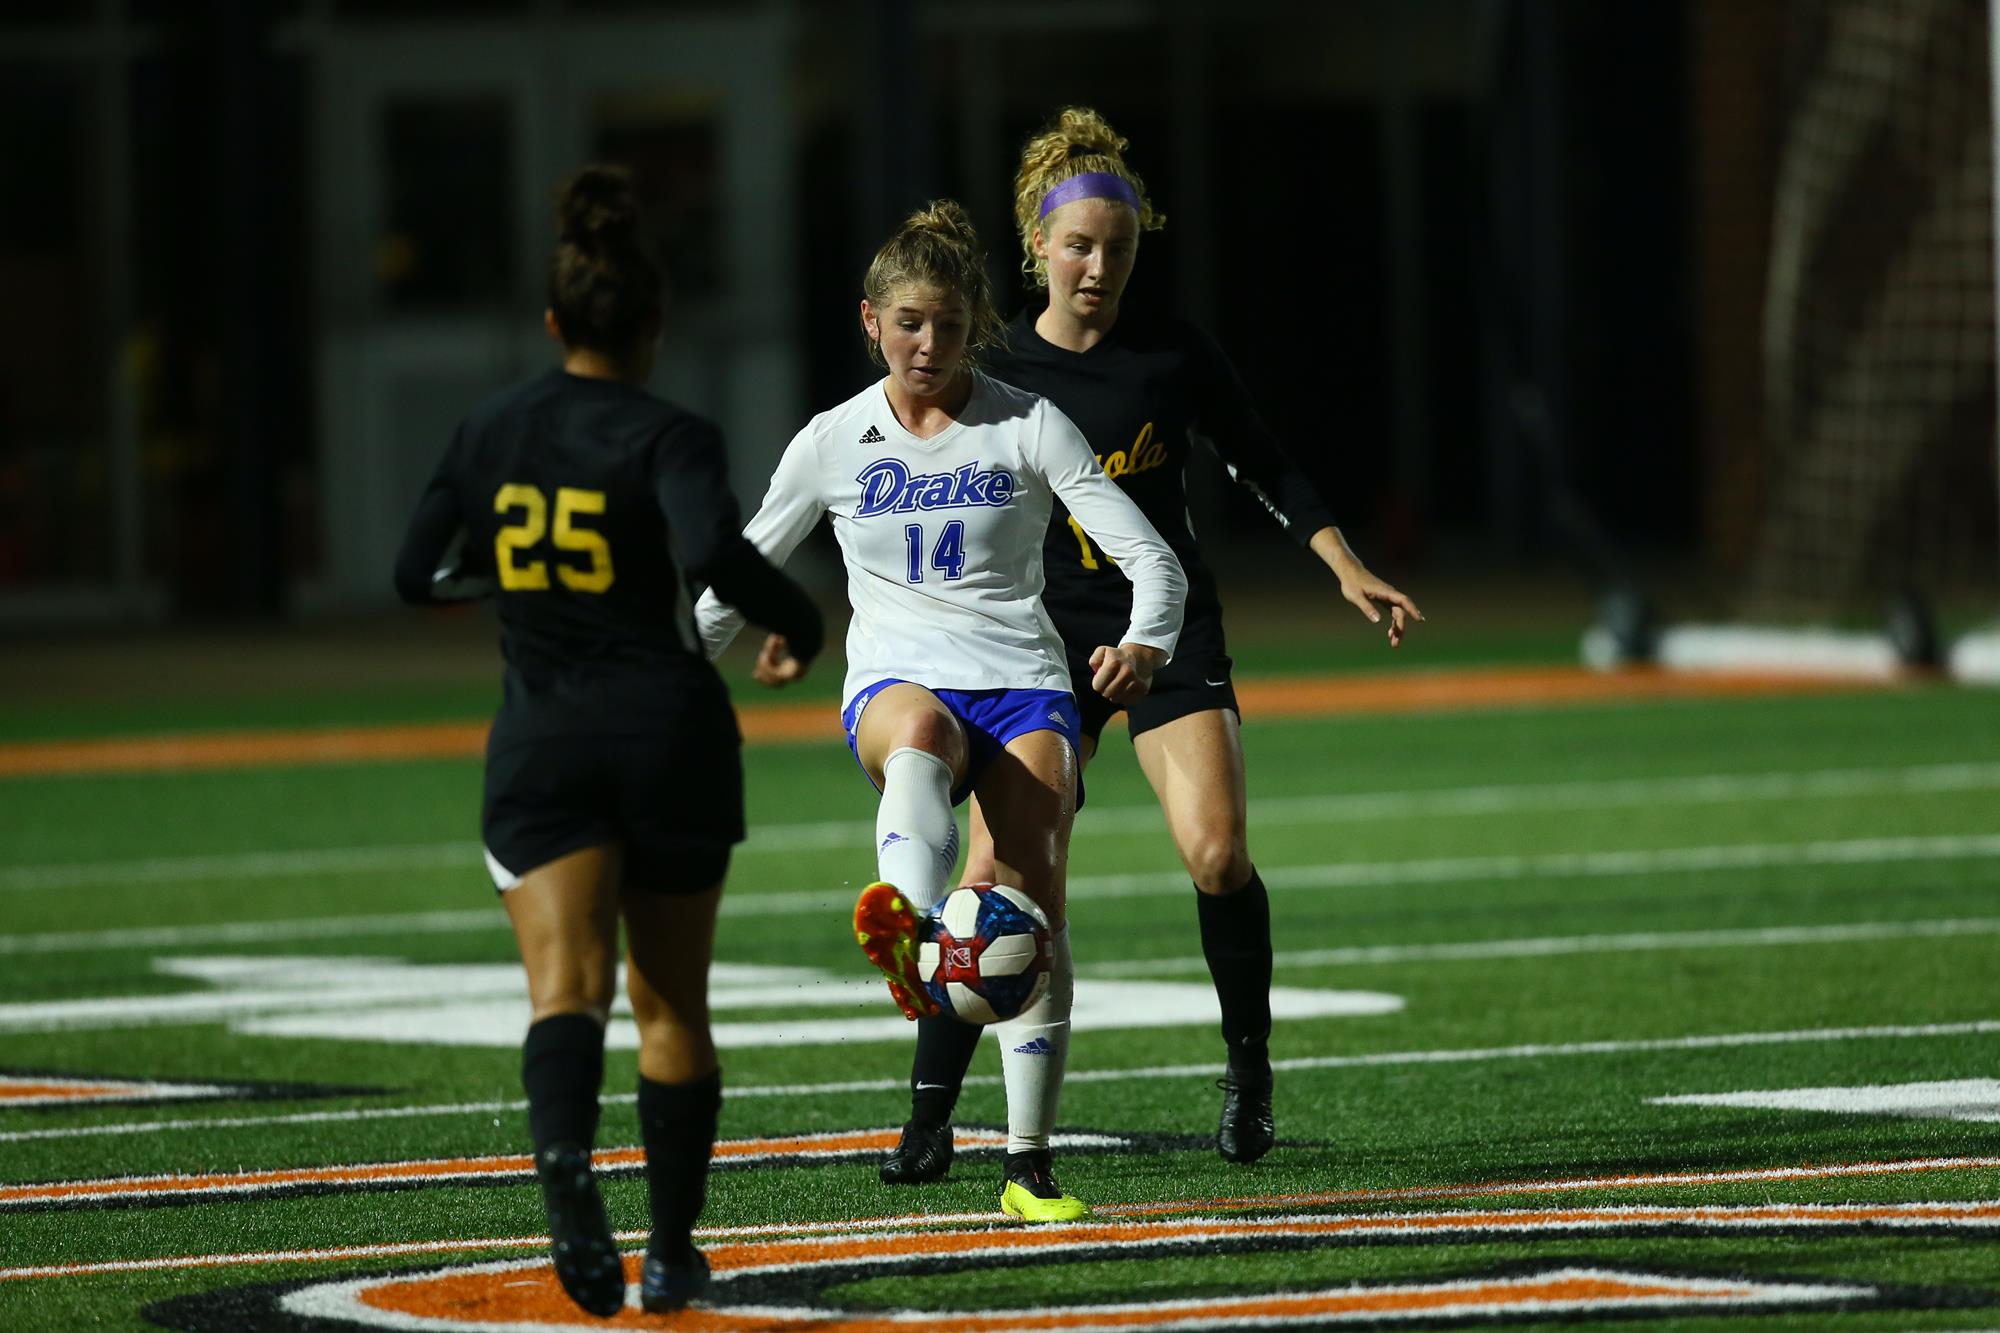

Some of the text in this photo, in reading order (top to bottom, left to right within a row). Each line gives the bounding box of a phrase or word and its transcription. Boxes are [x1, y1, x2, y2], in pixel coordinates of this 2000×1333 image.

[858, 435, 886, 444] adidas
[1095, 422, 1167, 480] ola
[853, 457, 1015, 519] Drake
[494, 482, 615, 594] 25
[905, 520, 966, 584] 14
[1067, 514, 1118, 570] 1
